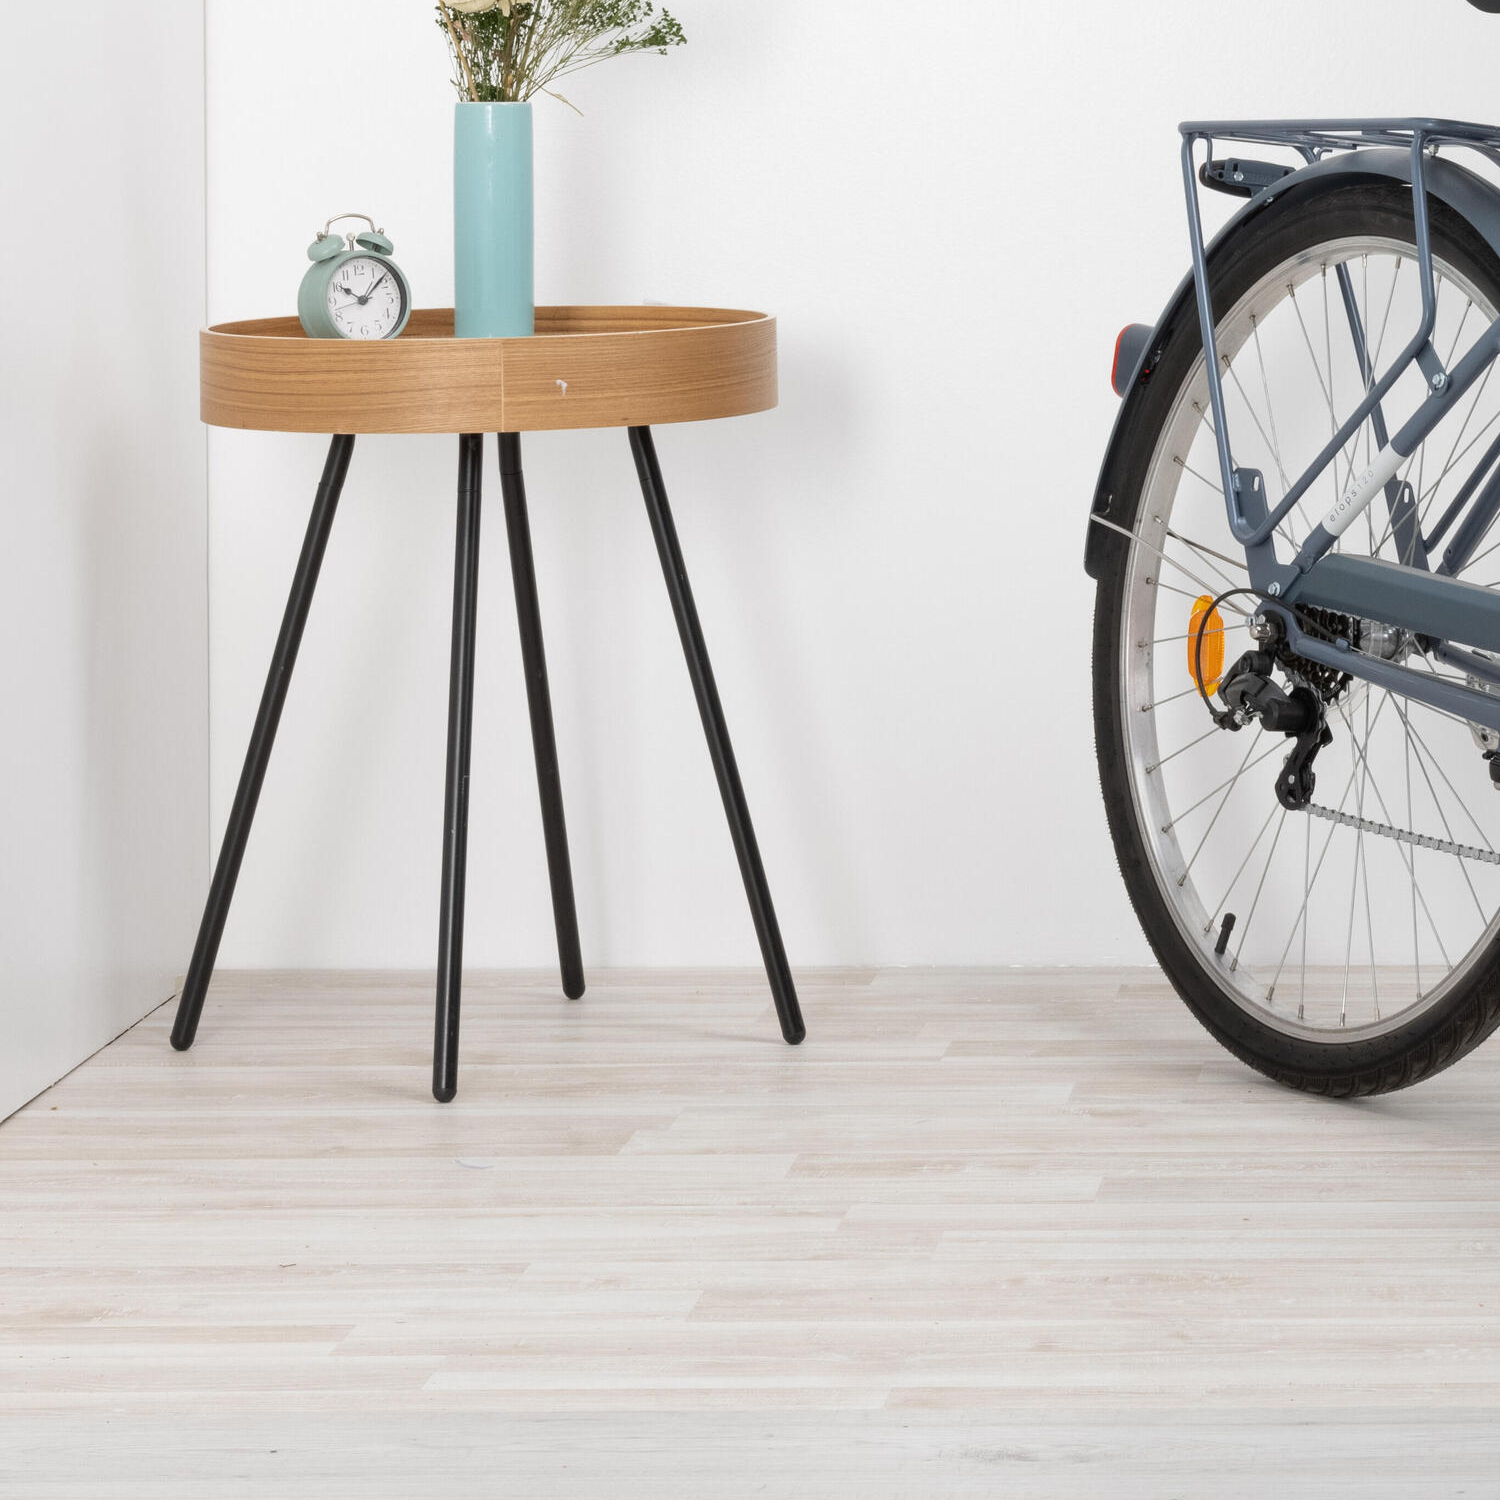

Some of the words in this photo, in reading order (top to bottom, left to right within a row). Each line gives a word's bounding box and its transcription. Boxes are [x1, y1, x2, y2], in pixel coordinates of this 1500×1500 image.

[342, 270, 349, 281] 11
[353, 264, 365, 276] 12
[1329, 490, 1357, 522] elops
[1359, 470, 1374, 489] 120
